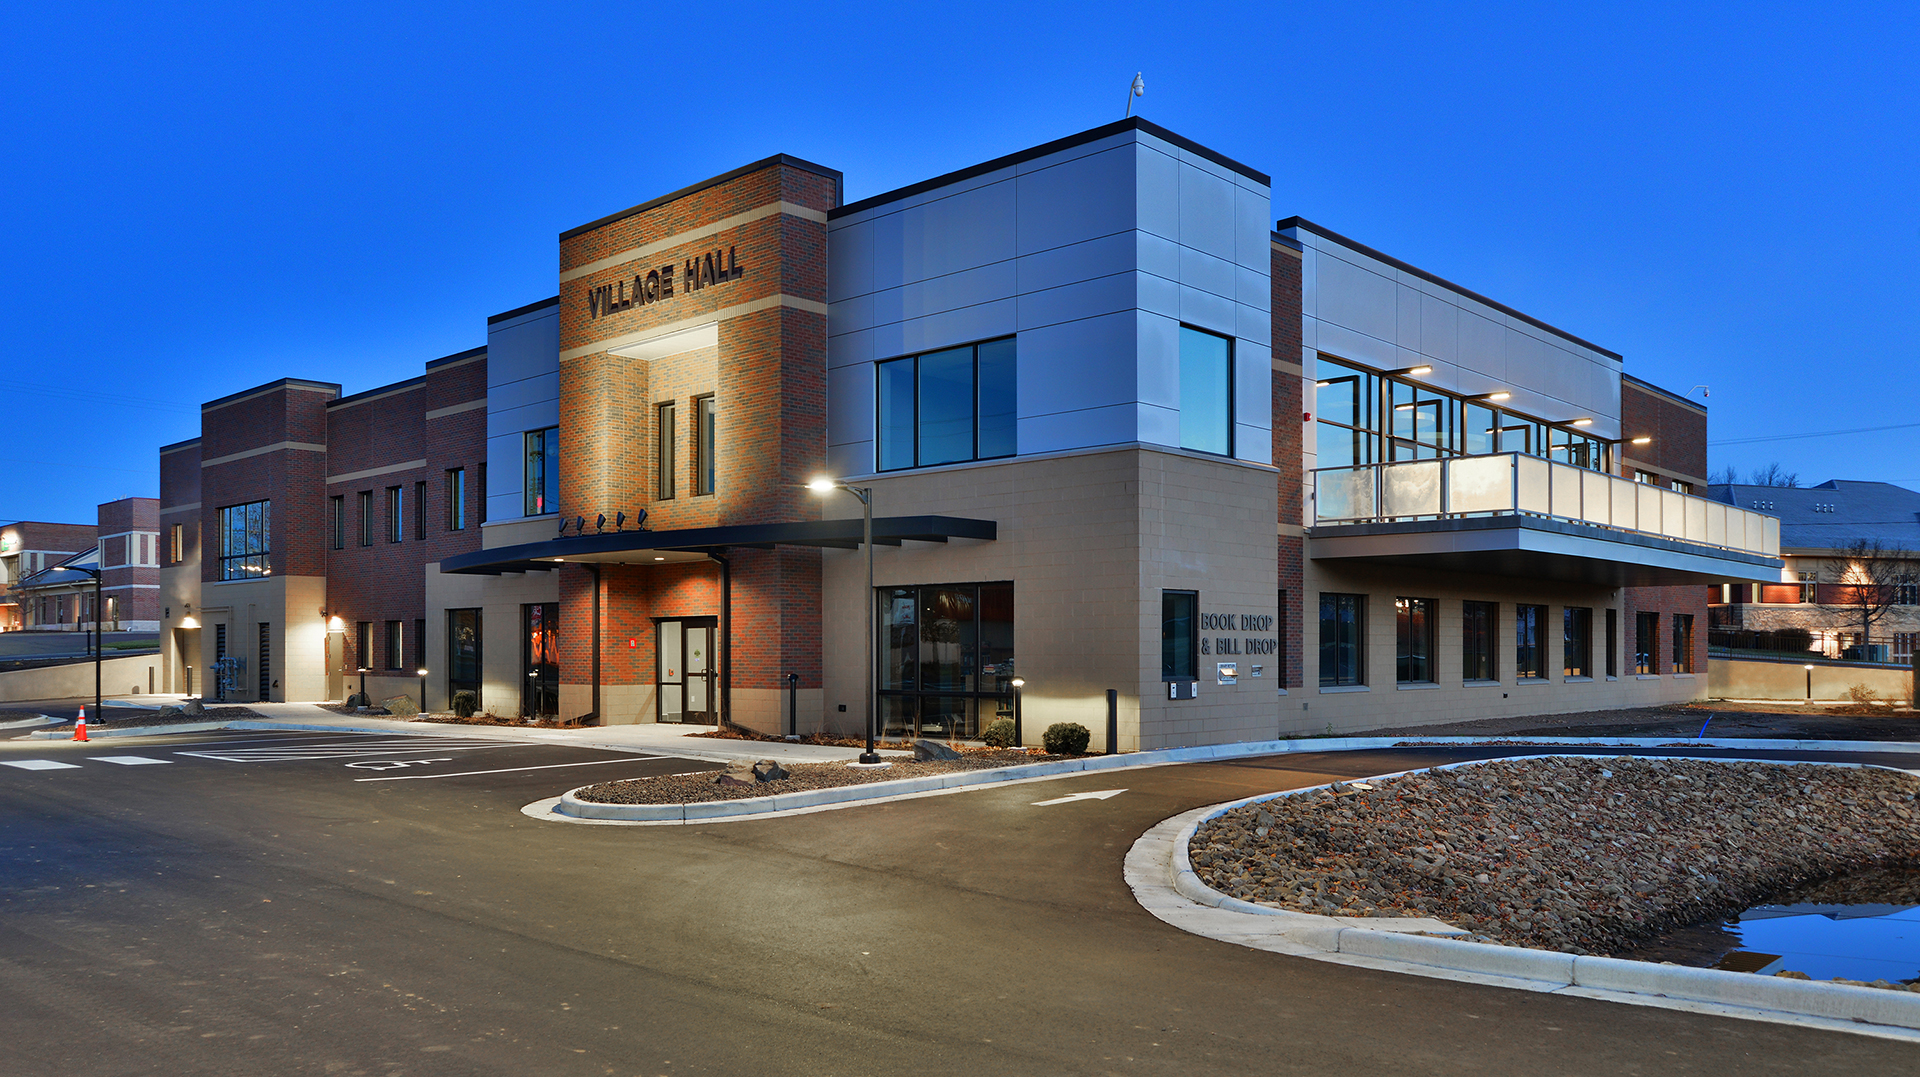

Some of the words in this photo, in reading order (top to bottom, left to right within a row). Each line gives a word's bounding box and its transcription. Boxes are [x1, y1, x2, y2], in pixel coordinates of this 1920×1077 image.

[588, 265, 674, 320] VILLAGE
[684, 246, 743, 293] HALL
[1201, 612, 1237, 631] BOOK
[1241, 614, 1274, 632] DROP
[1201, 637, 1210, 655] &
[1216, 637, 1242, 655] BILL
[1245, 638, 1278, 655] DROP
